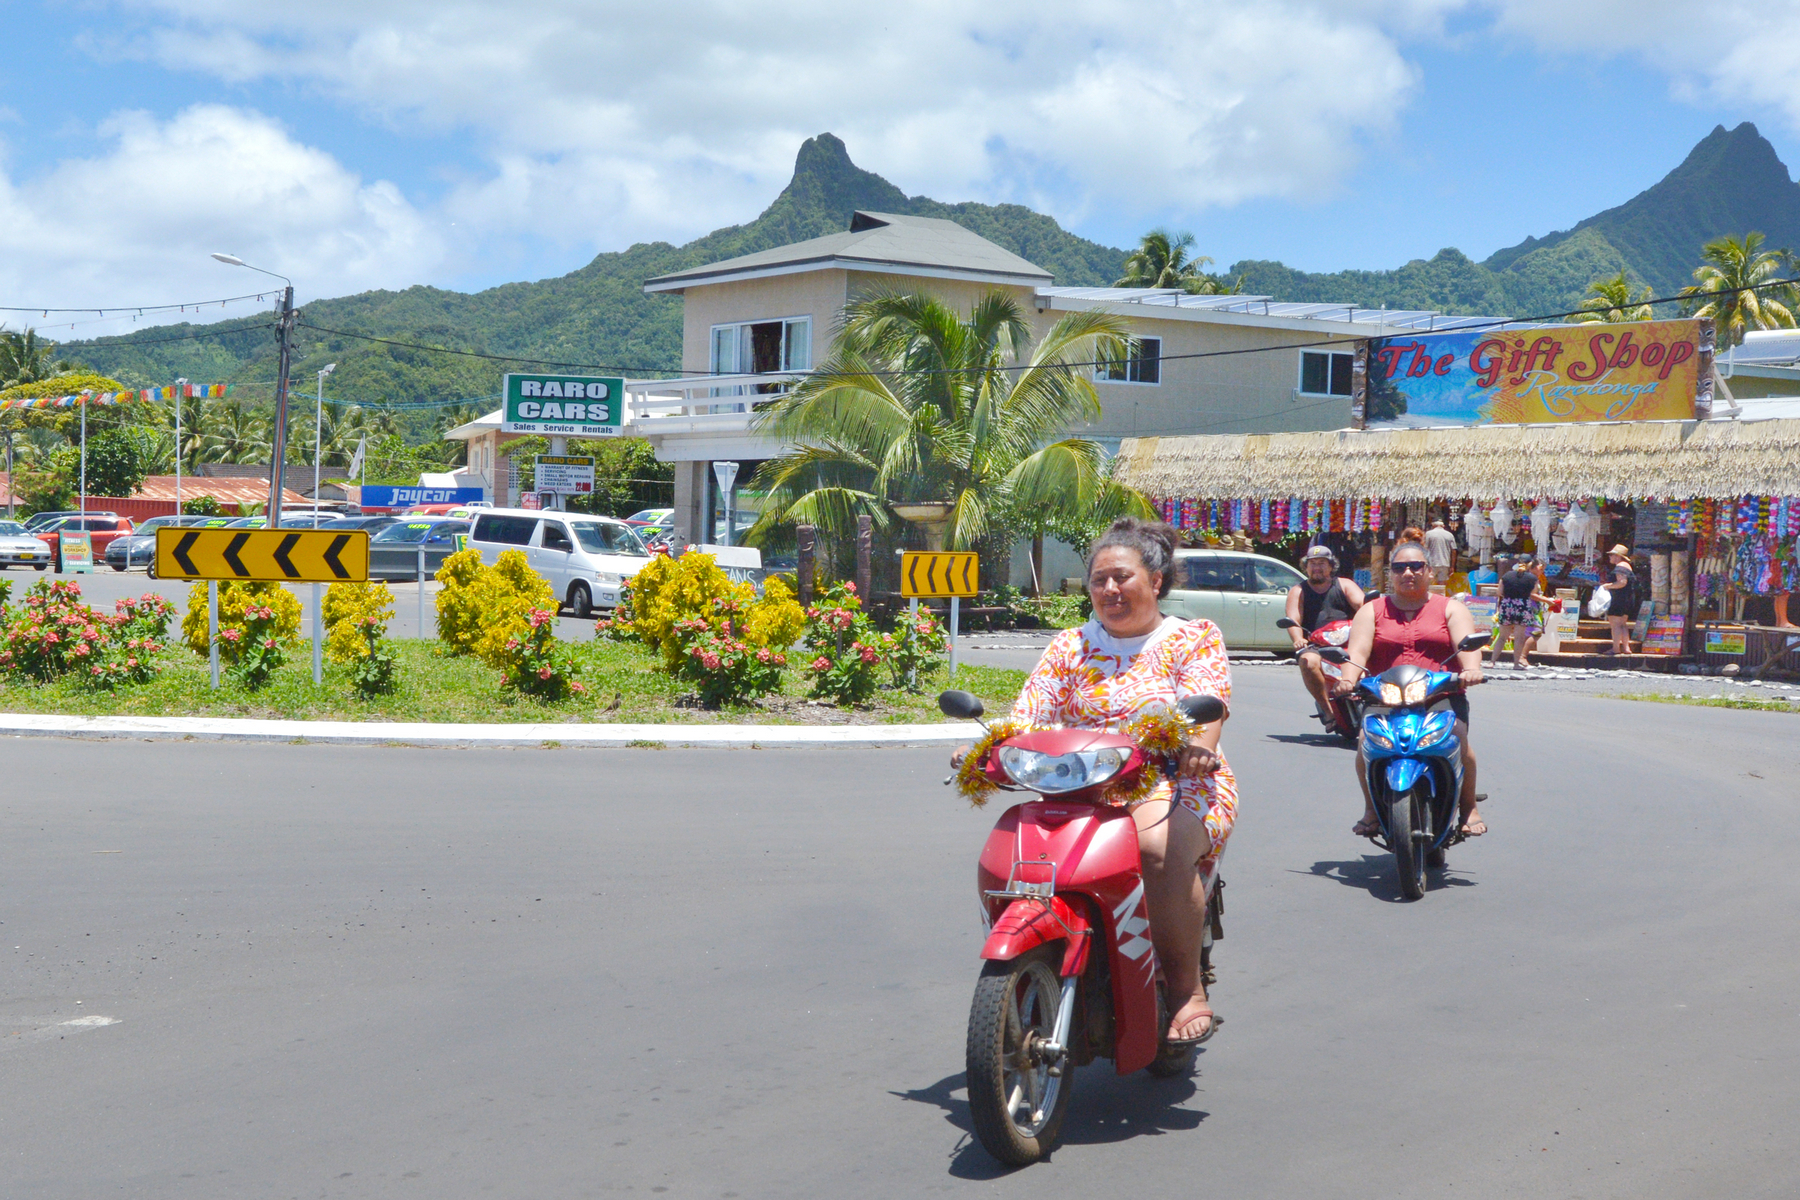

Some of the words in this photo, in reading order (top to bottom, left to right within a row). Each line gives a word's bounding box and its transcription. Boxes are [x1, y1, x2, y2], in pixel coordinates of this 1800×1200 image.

[1377, 340, 1455, 378] The
[1469, 336, 1564, 388] Gift
[1567, 331, 1695, 382] Shop
[521, 380, 609, 400] RARO
[1516, 368, 1660, 419] Rarotonga
[517, 401, 609, 421] CARS
[513, 423, 536, 431] Sales
[543, 424, 575, 432] Service
[582, 425, 613, 434] Rentals
[388, 488, 456, 505] Jaycar
